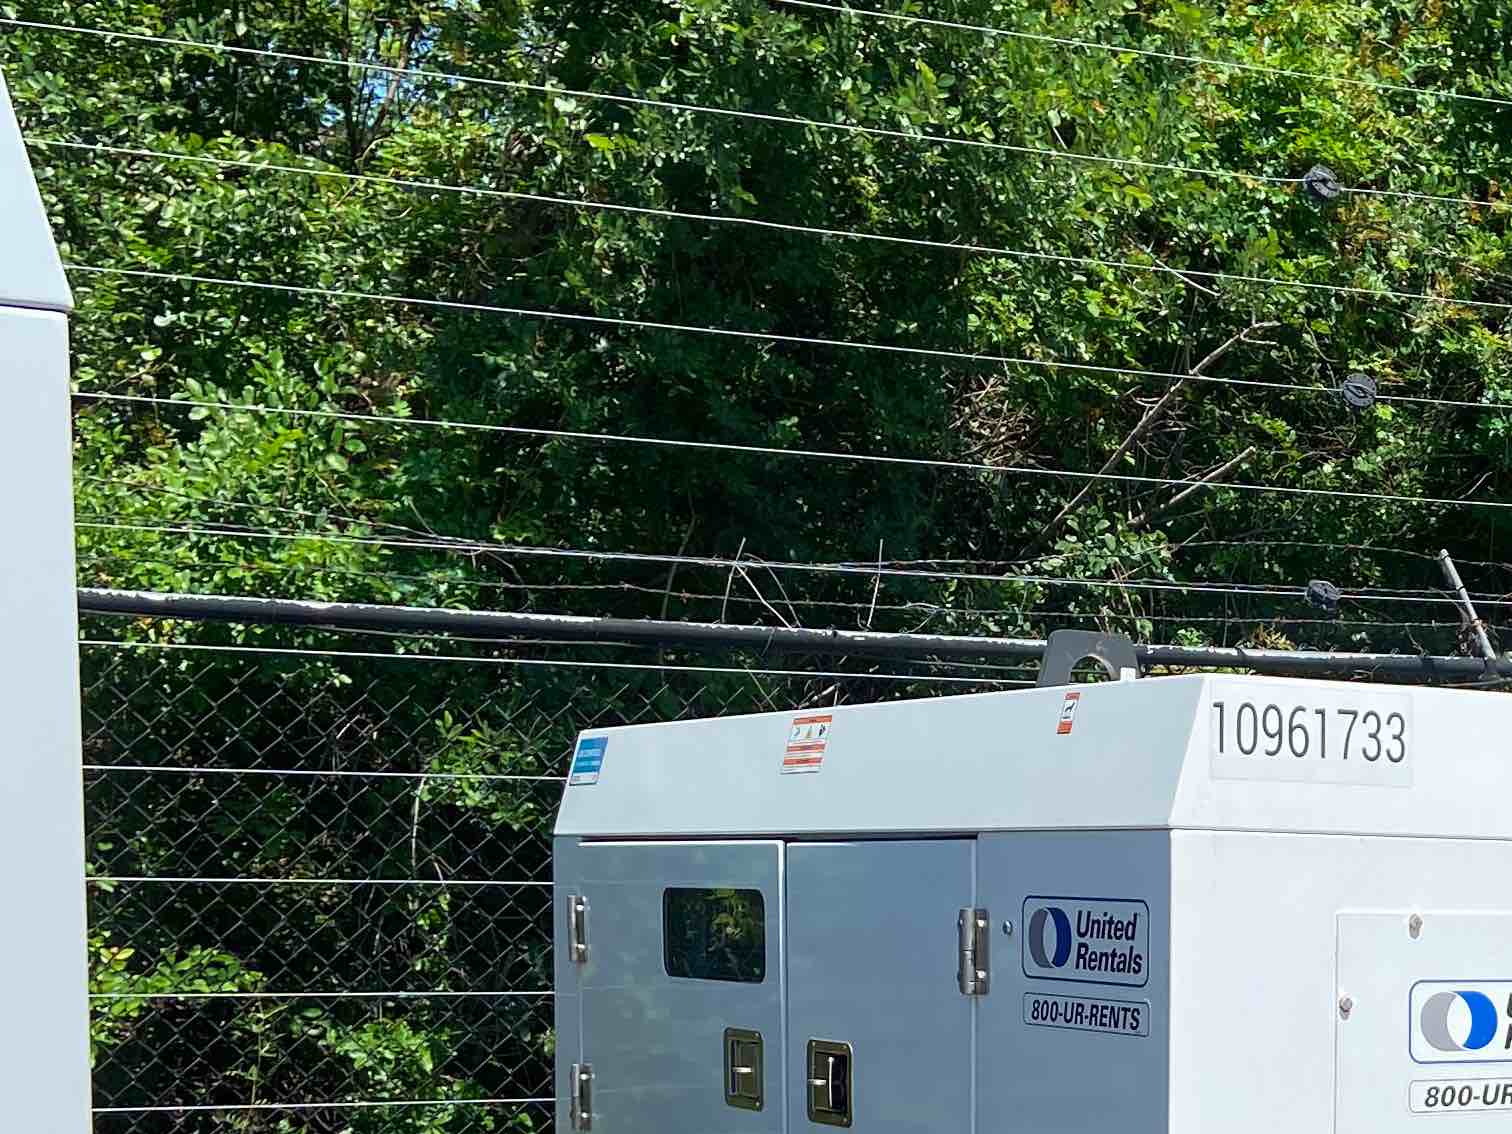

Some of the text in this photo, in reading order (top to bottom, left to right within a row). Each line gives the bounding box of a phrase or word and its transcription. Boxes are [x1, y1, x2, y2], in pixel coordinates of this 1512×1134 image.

[1212, 701, 1406, 763] 10961733
[1076, 910, 1138, 941] United
[1075, 942, 1143, 974] Rentals
[1031, 999, 1141, 1031] 800-UR-RENTS
